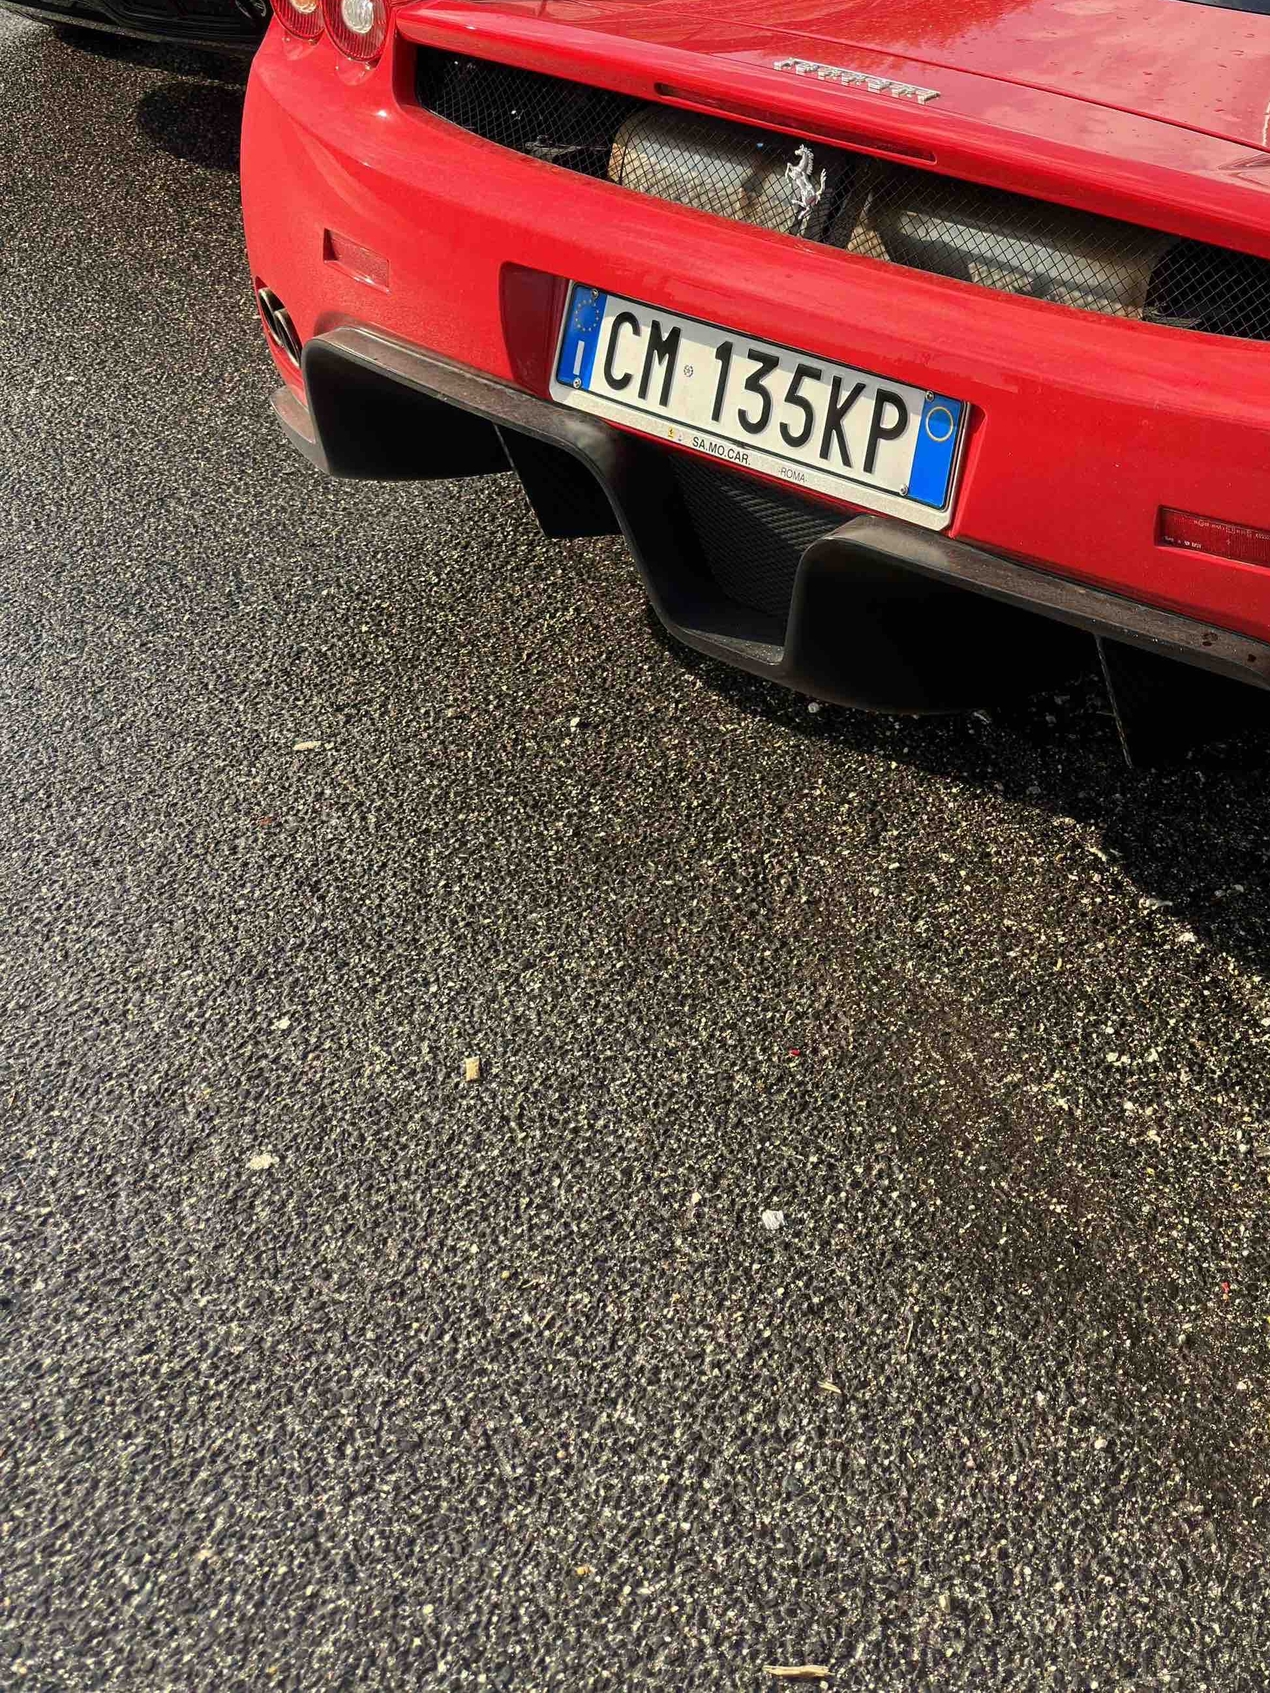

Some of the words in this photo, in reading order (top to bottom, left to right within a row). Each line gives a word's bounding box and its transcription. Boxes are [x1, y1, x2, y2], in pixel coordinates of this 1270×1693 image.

[773, 57, 941, 105] Ferrari
[603, 311, 682, 407] CM
[711, 340, 908, 474] 135KP
